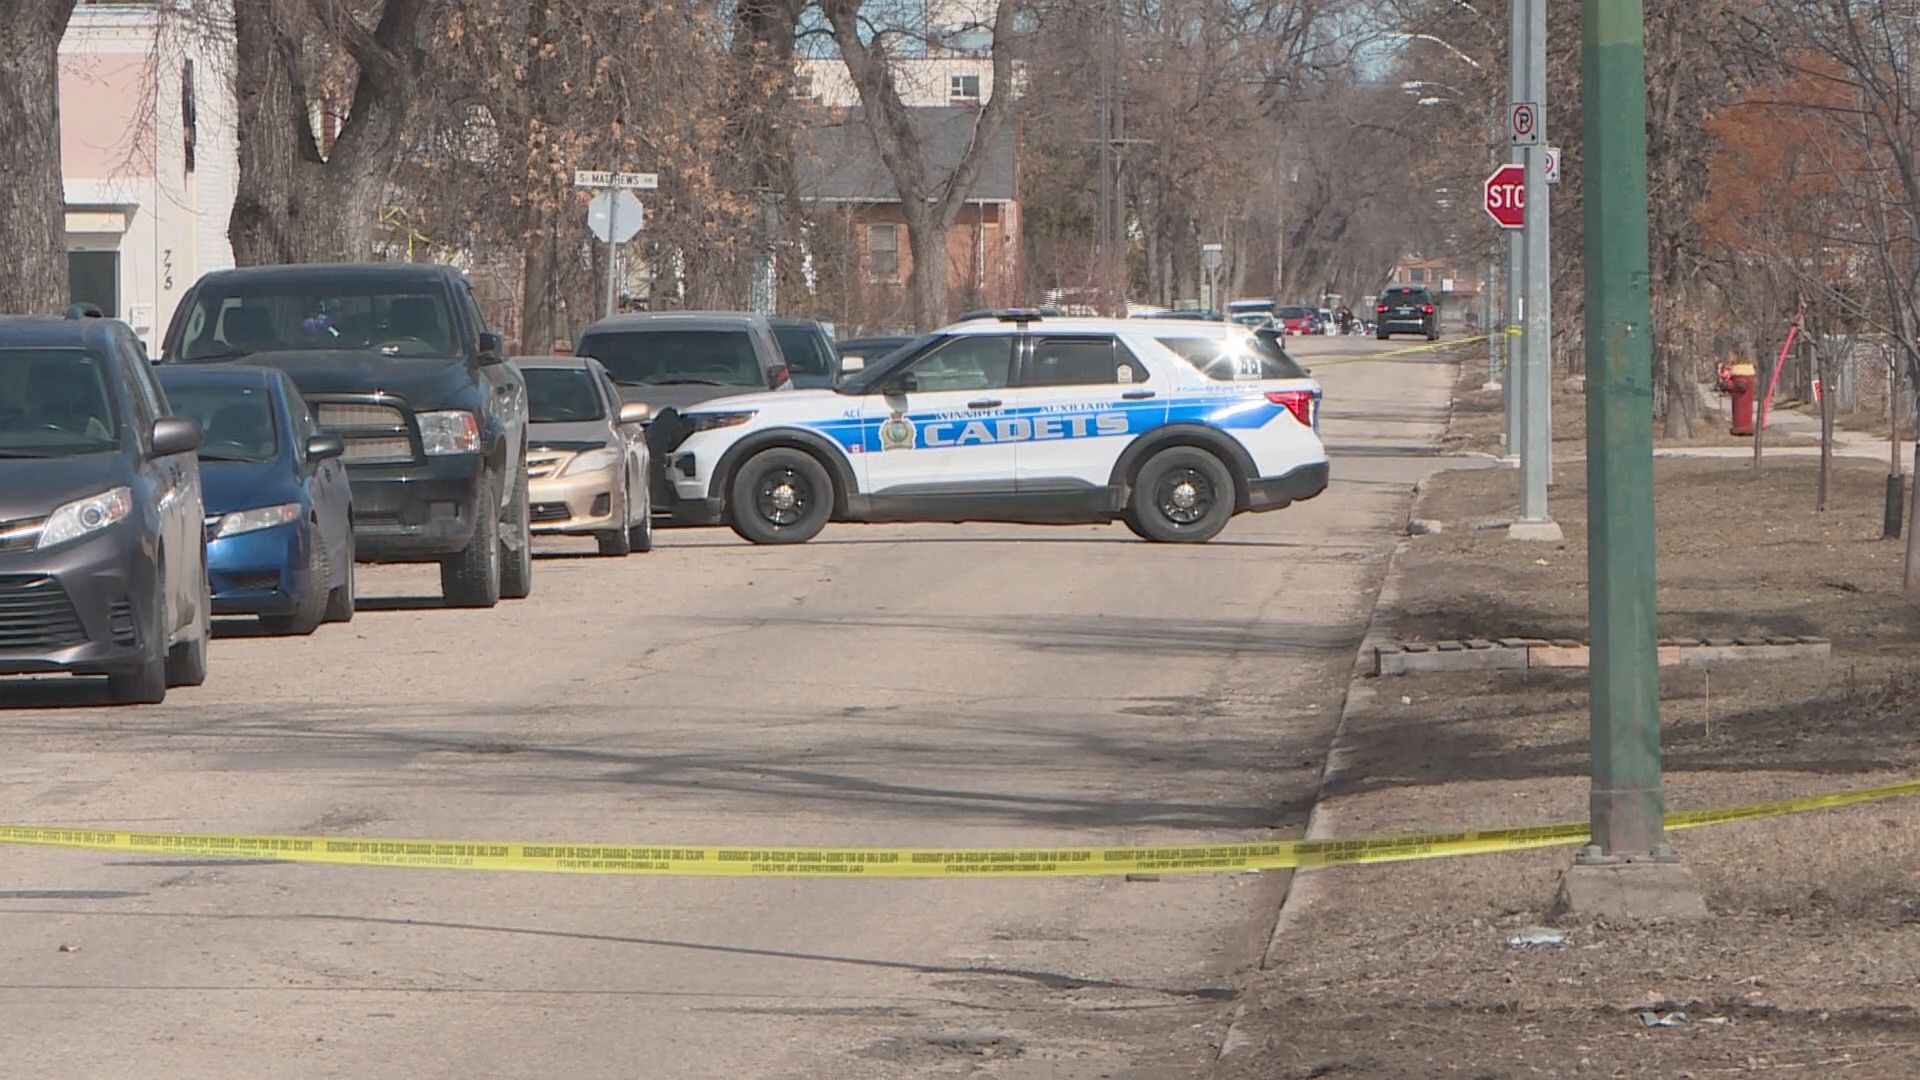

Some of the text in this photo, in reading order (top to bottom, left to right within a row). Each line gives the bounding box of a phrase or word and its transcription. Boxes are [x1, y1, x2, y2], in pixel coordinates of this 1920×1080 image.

[1489, 184, 1525, 208] STO
[163, 249, 173, 290] 775
[935, 408, 1005, 420] WINNIPEG
[1040, 402, 1114, 414] AUXILIARY
[923, 412, 1129, 447] CADETS
